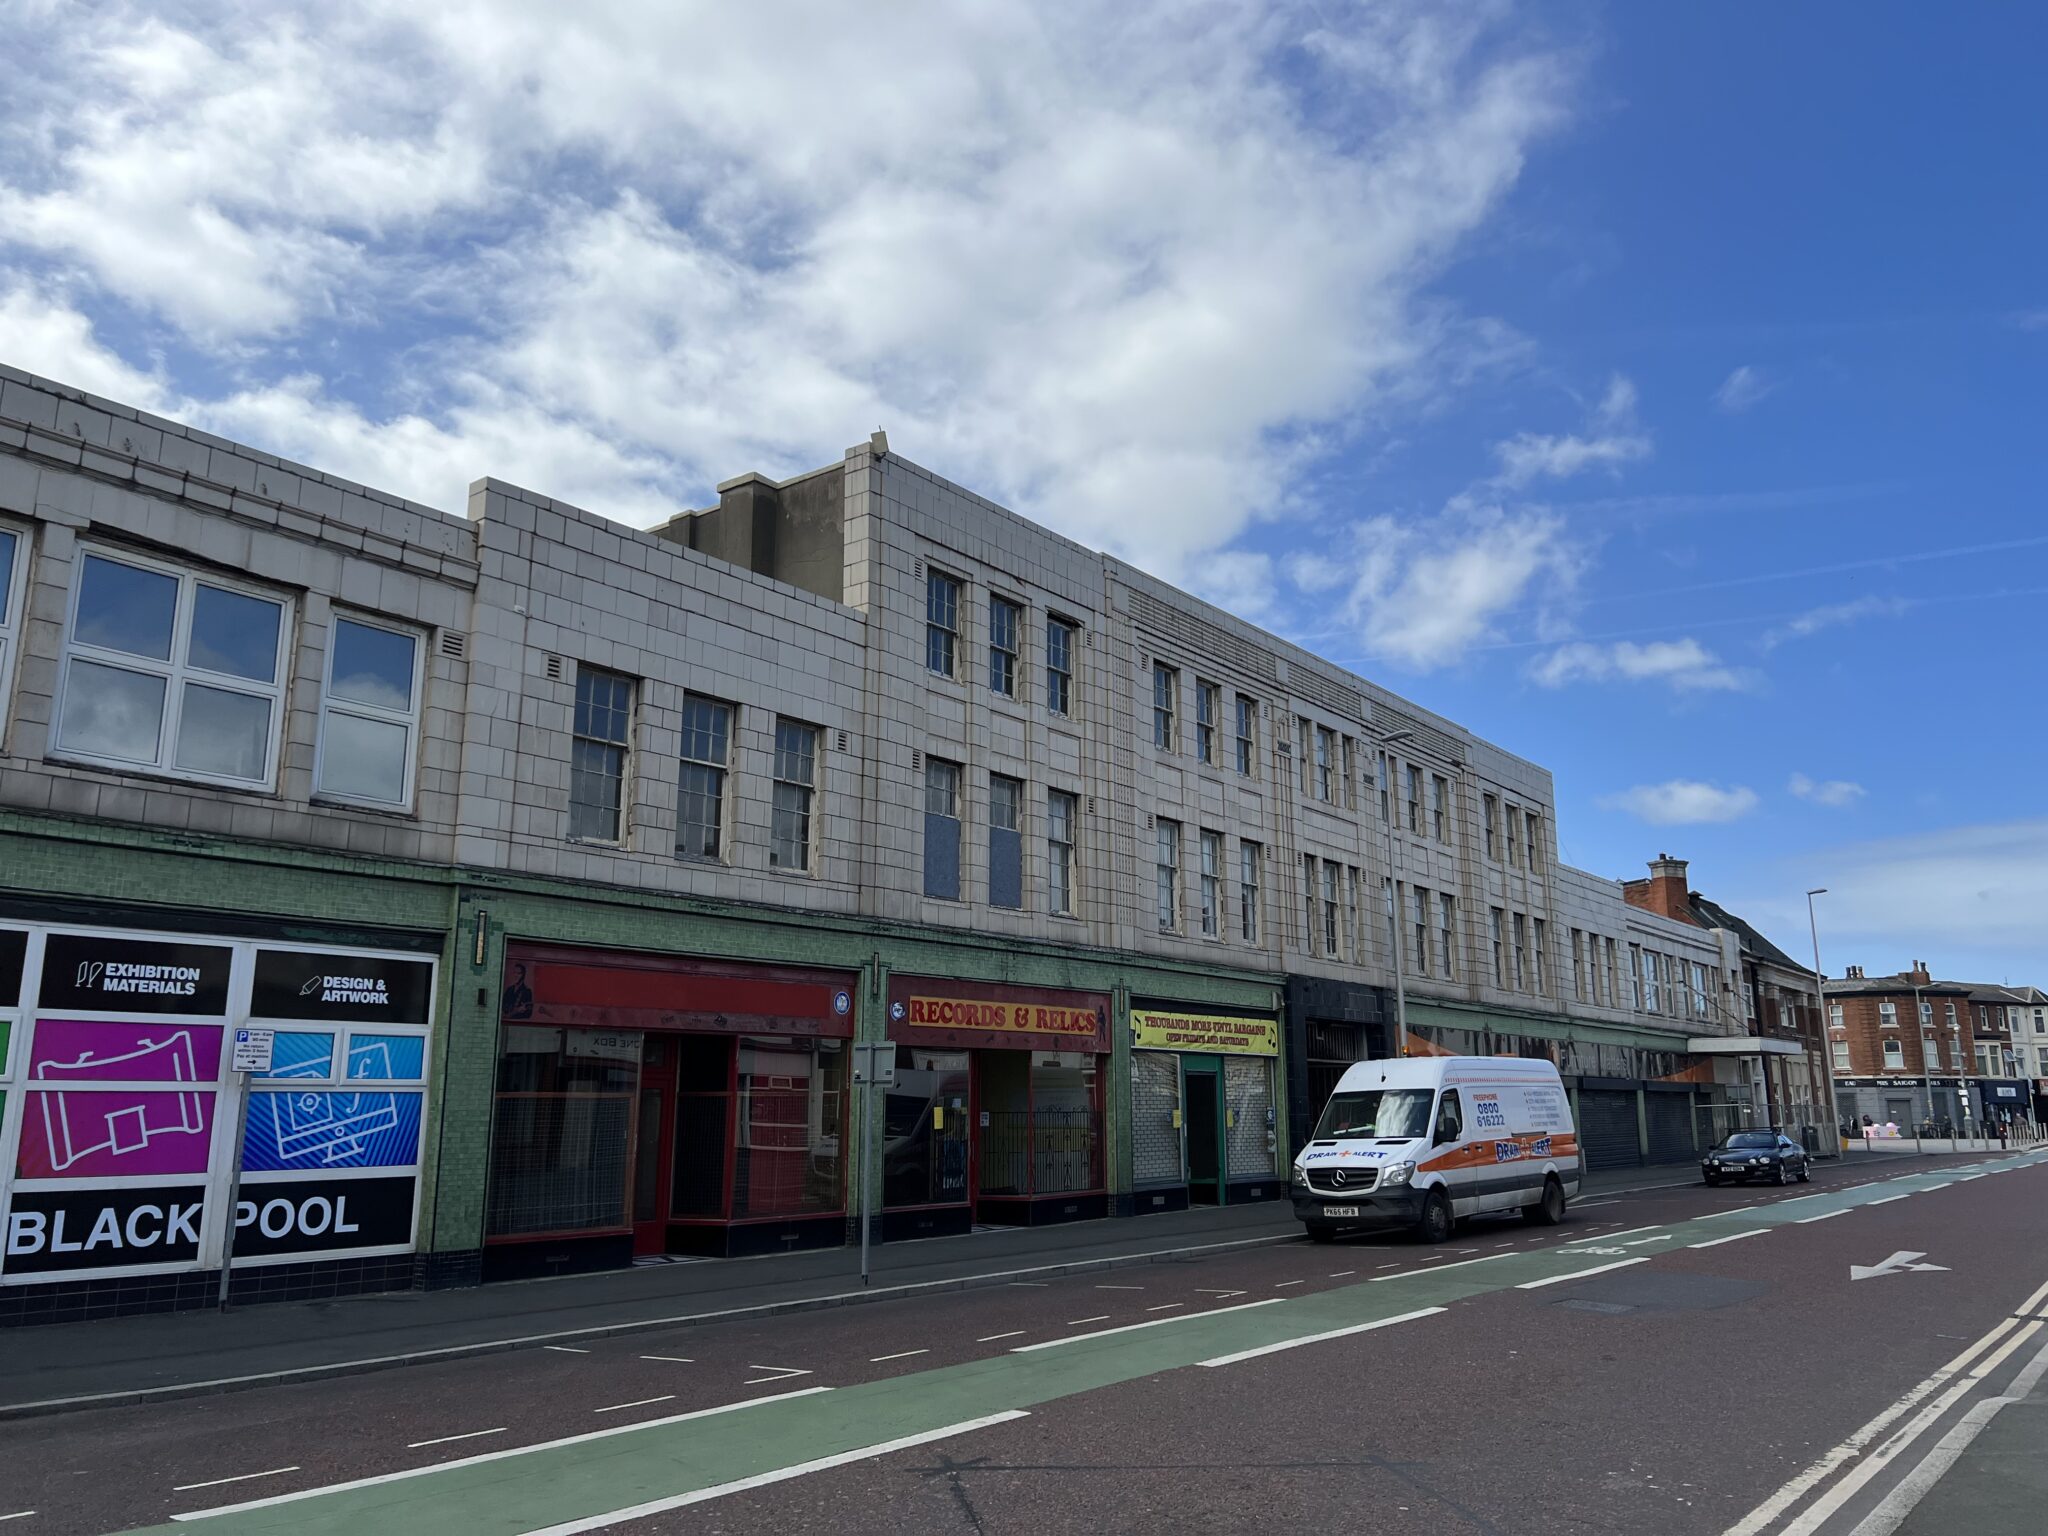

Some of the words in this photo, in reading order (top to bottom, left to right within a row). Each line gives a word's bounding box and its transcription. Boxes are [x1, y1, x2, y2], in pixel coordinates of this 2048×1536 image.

[105, 963, 200, 980] EXHIBITION
[103, 978, 196, 995] MATERIALS
[323, 976, 374, 990] DESIGN
[376, 979, 386, 991] &
[321, 990, 389, 1004] ARTWORK
[910, 1000, 1005, 1027] RECORDS
[1014, 1007, 1029, 1028] &
[1035, 1008, 1096, 1032] RELICS
[1145, 1016, 1190, 1030] THOUSANDS
[1191, 1019, 1212, 1031] MORE
[1213, 1021, 1233, 1033] VINYL
[1234, 1023, 1266, 1036] BARGAINS
[239, 1031, 247, 1041] P
[1166, 1032, 1182, 1042] OPEN
[1206, 1035, 1219, 1045] AND
[1477, 1103, 1499, 1115] 0800
[1477, 1114, 1505, 1127] 616222
[1306, 1152, 1338, 1161] DRAIN
[1352, 1151, 1388, 1159] ALERT
[1325, 1207, 1341, 1216] PK65
[1342, 1207, 1356, 1216] HFB
[7, 1202, 204, 1256] BLACK
[234, 1195, 359, 1239] POOL
